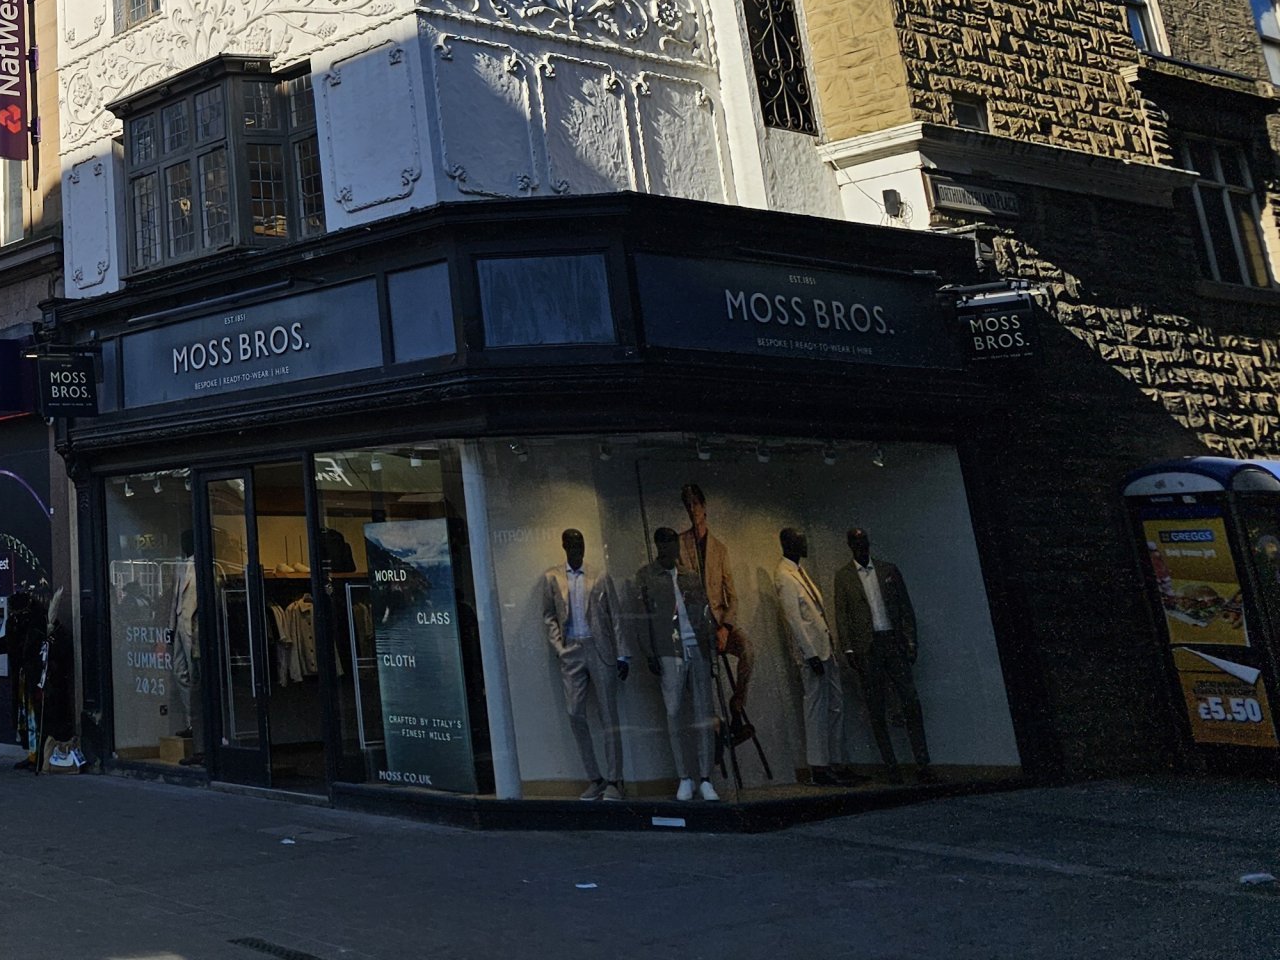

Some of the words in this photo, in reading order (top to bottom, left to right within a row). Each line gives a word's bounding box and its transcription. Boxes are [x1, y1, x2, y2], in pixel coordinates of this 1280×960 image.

[724, 288, 806, 328] MOSS
[812, 298, 896, 335] BROS.
[970, 314, 1021, 334] MOSS
[172, 337, 232, 374] MOSS
[238, 322, 310, 361] BROS.
[973, 332, 1031, 351] BROS.
[50, 371, 87, 384] MOSS
[194, 379, 218, 391] BESPOKE
[222, 369, 269, 386] READY-TO-WEAR
[274, 365, 289, 376] HIRE
[51, 385, 91, 399] BROS.
[1170, 530, 1212, 542] GREGGS
[374, 569, 407, 583] WORLD
[416, 611, 451, 626] CLASS
[126, 625, 174, 645] SPRING
[127, 650, 173, 671] SUMMER
[383, 654, 417, 669] CLOTH
[135, 676, 166, 696] 2025
[1198, 696, 1264, 724] £5.50
[388, 714, 417, 726] CRAFTED
[419, 717, 429, 727] BY
[432, 717, 463, 730] ITALY'S
[401, 727, 425, 739] FINEST
[428, 730, 452, 742] MILLS
[378, 769, 433, 786] MOSS.CO.UK
